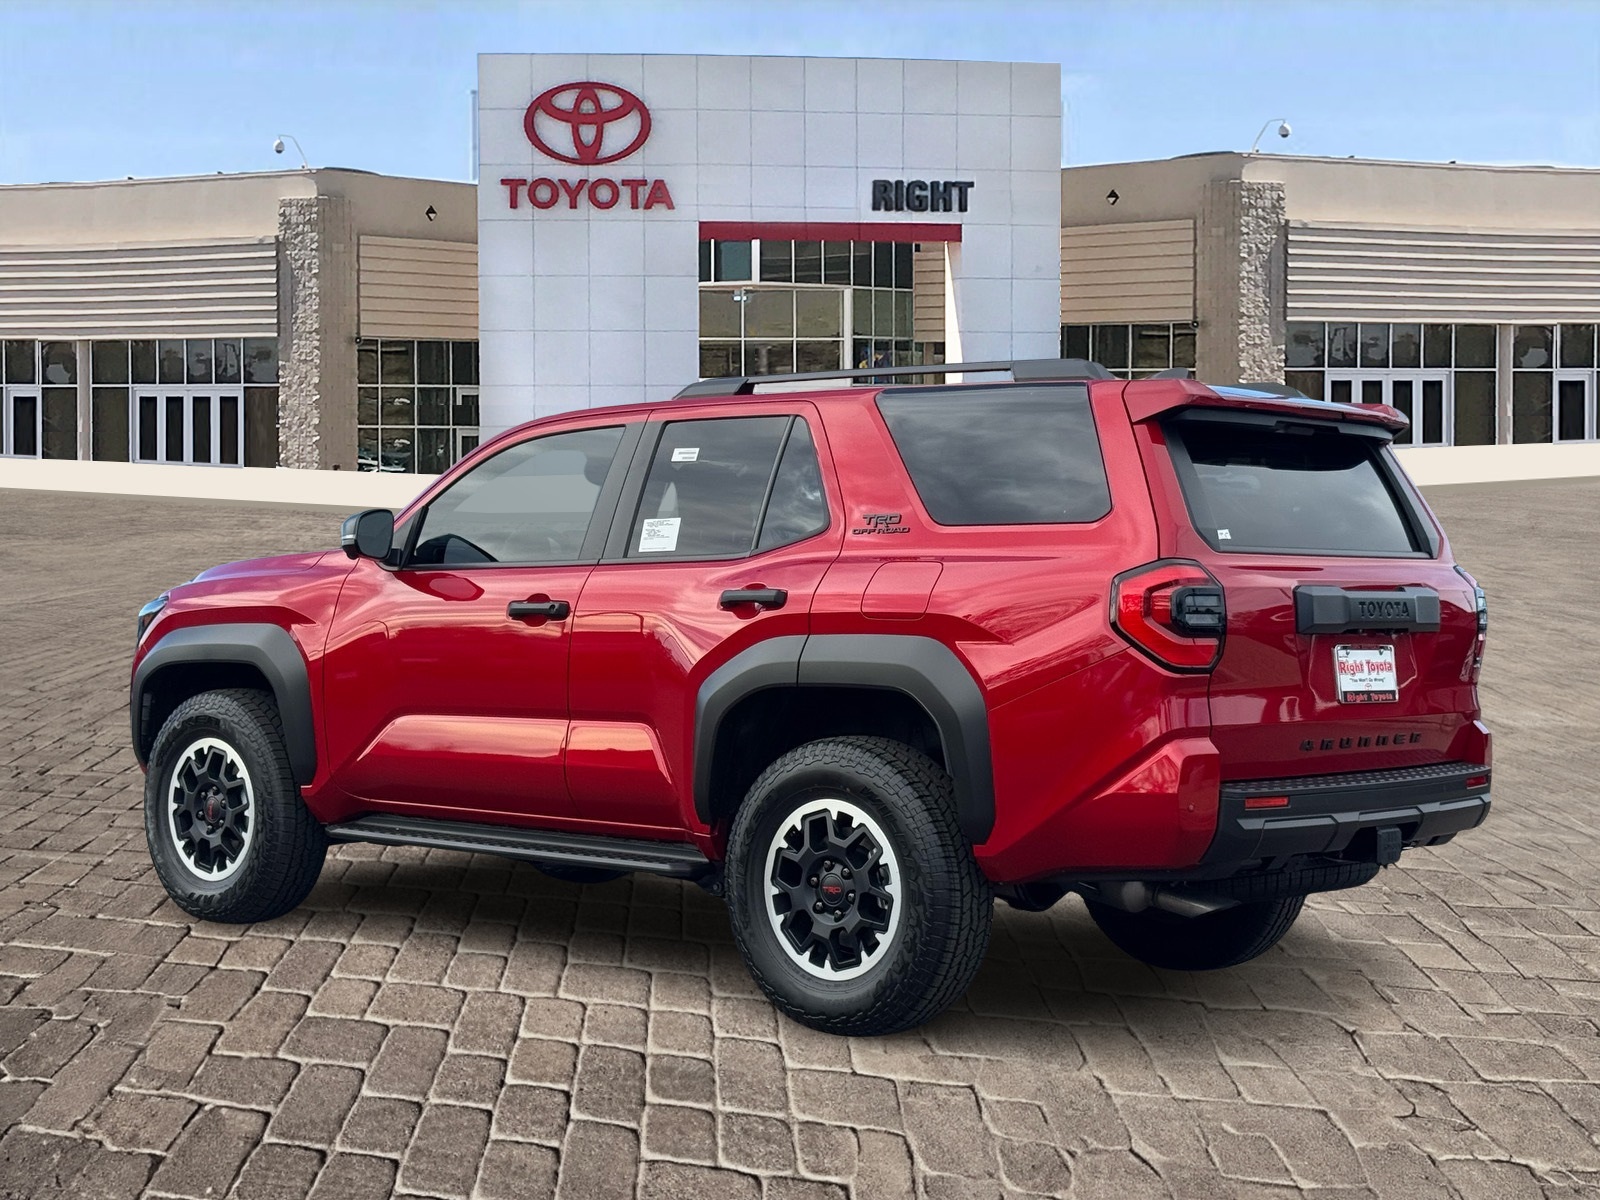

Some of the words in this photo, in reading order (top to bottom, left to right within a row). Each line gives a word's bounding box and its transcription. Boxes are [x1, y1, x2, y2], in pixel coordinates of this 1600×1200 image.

[500, 178, 675, 210] TOYOTA
[871, 179, 975, 212] RIGHT
[862, 513, 902, 528] TRD
[1358, 601, 1410, 618] TOYOTA
[1338, 659, 1364, 677] Right
[1365, 659, 1393, 675] Toyota
[1347, 692, 1367, 702] Right
[1370, 692, 1393, 701] Toyota
[822, 886, 841, 894] TRD
